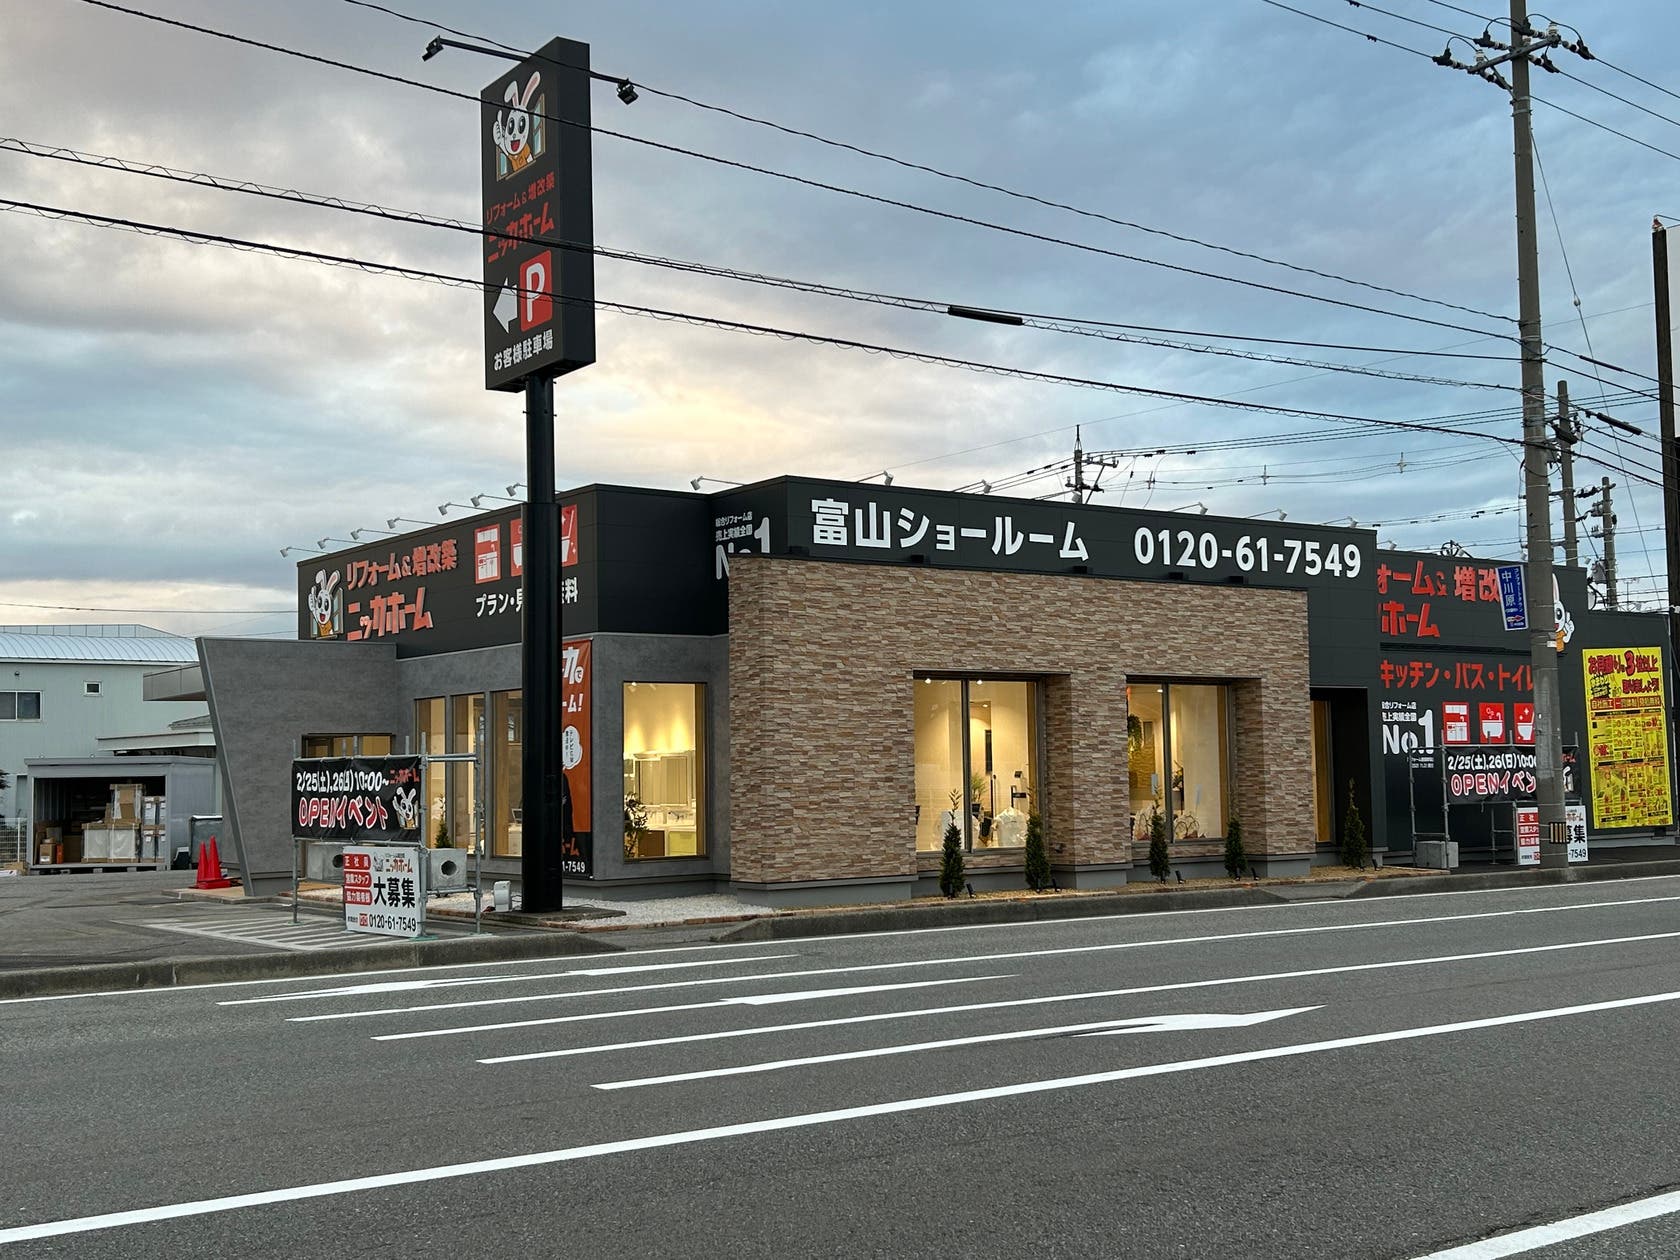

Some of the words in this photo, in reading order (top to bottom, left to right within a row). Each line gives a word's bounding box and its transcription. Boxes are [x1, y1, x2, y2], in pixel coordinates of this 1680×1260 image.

[526, 262, 546, 322] P
[494, 328, 553, 371] お客様駐車場
[811, 498, 1089, 562] 富山ショールーム
[1134, 526, 1361, 578] 0120-61-7549
[1501, 570, 1516, 607] 中川原
[346, 587, 433, 641] ニッカホーム
[1378, 600, 1440, 637] ホーム
[298, 795, 389, 830] OPENイベント
[373, 876, 416, 909] 大募集
[369, 913, 417, 932] 0120-61-7549
